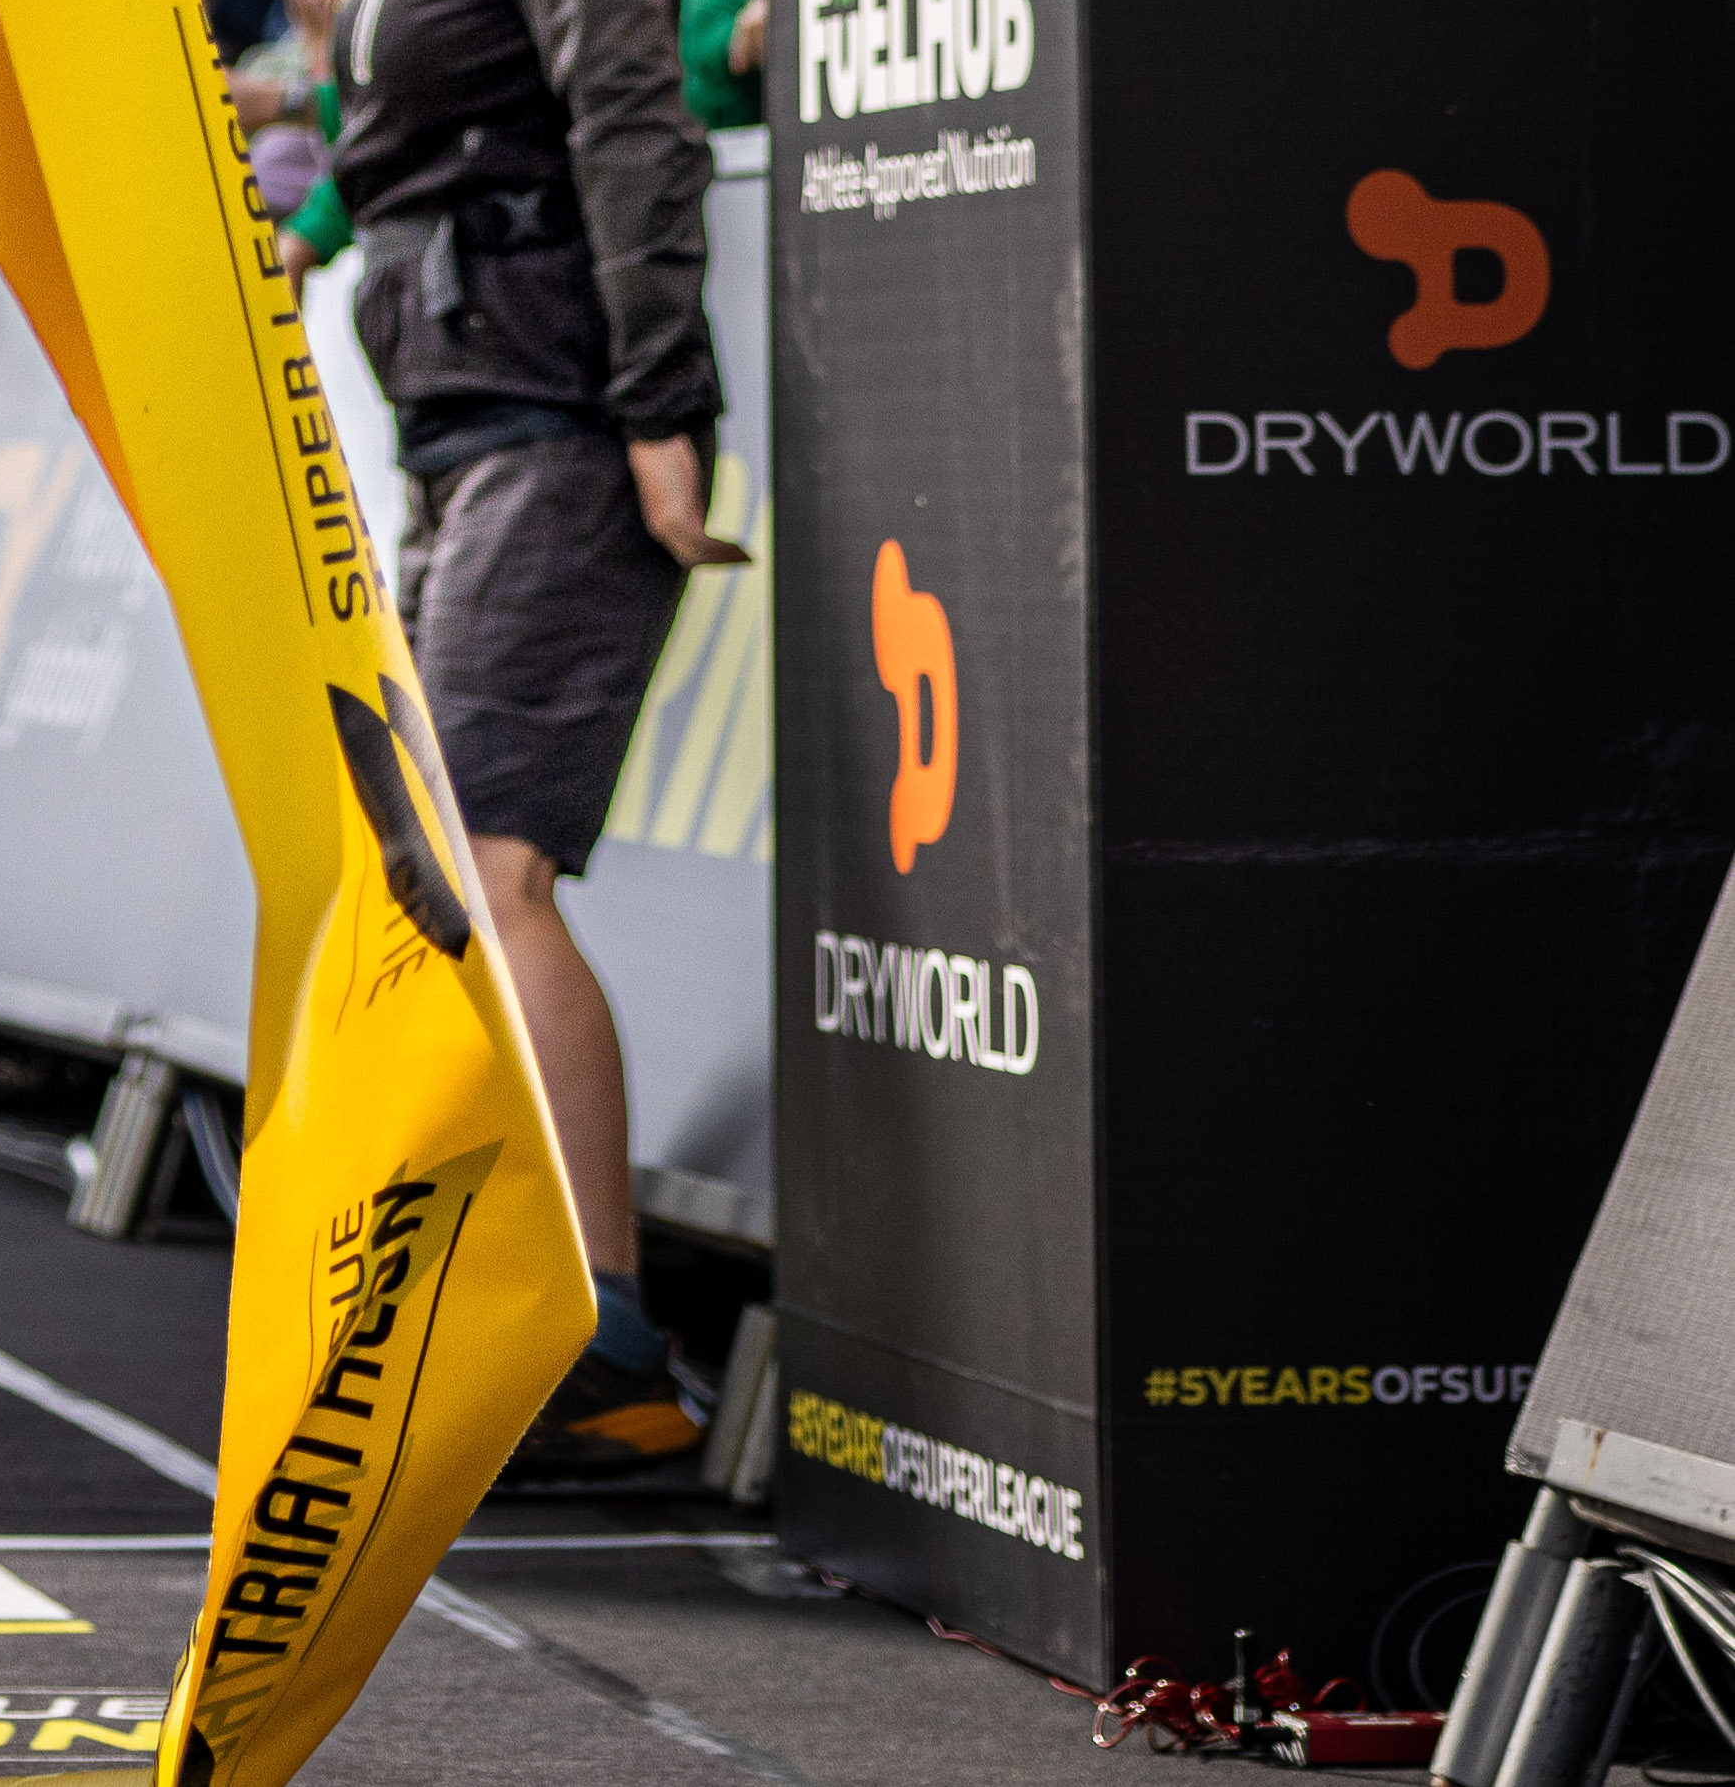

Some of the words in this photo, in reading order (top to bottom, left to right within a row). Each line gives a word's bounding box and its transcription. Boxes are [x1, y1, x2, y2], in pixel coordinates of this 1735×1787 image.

[801, 144, 867, 213] Athlete
[863, 127, 948, 221] Approved
[283, 353, 371, 624] SUPER
[1185, 411, 1730, 476] DRYWORLD
[815, 931, 1039, 1076] DRYWORLD
